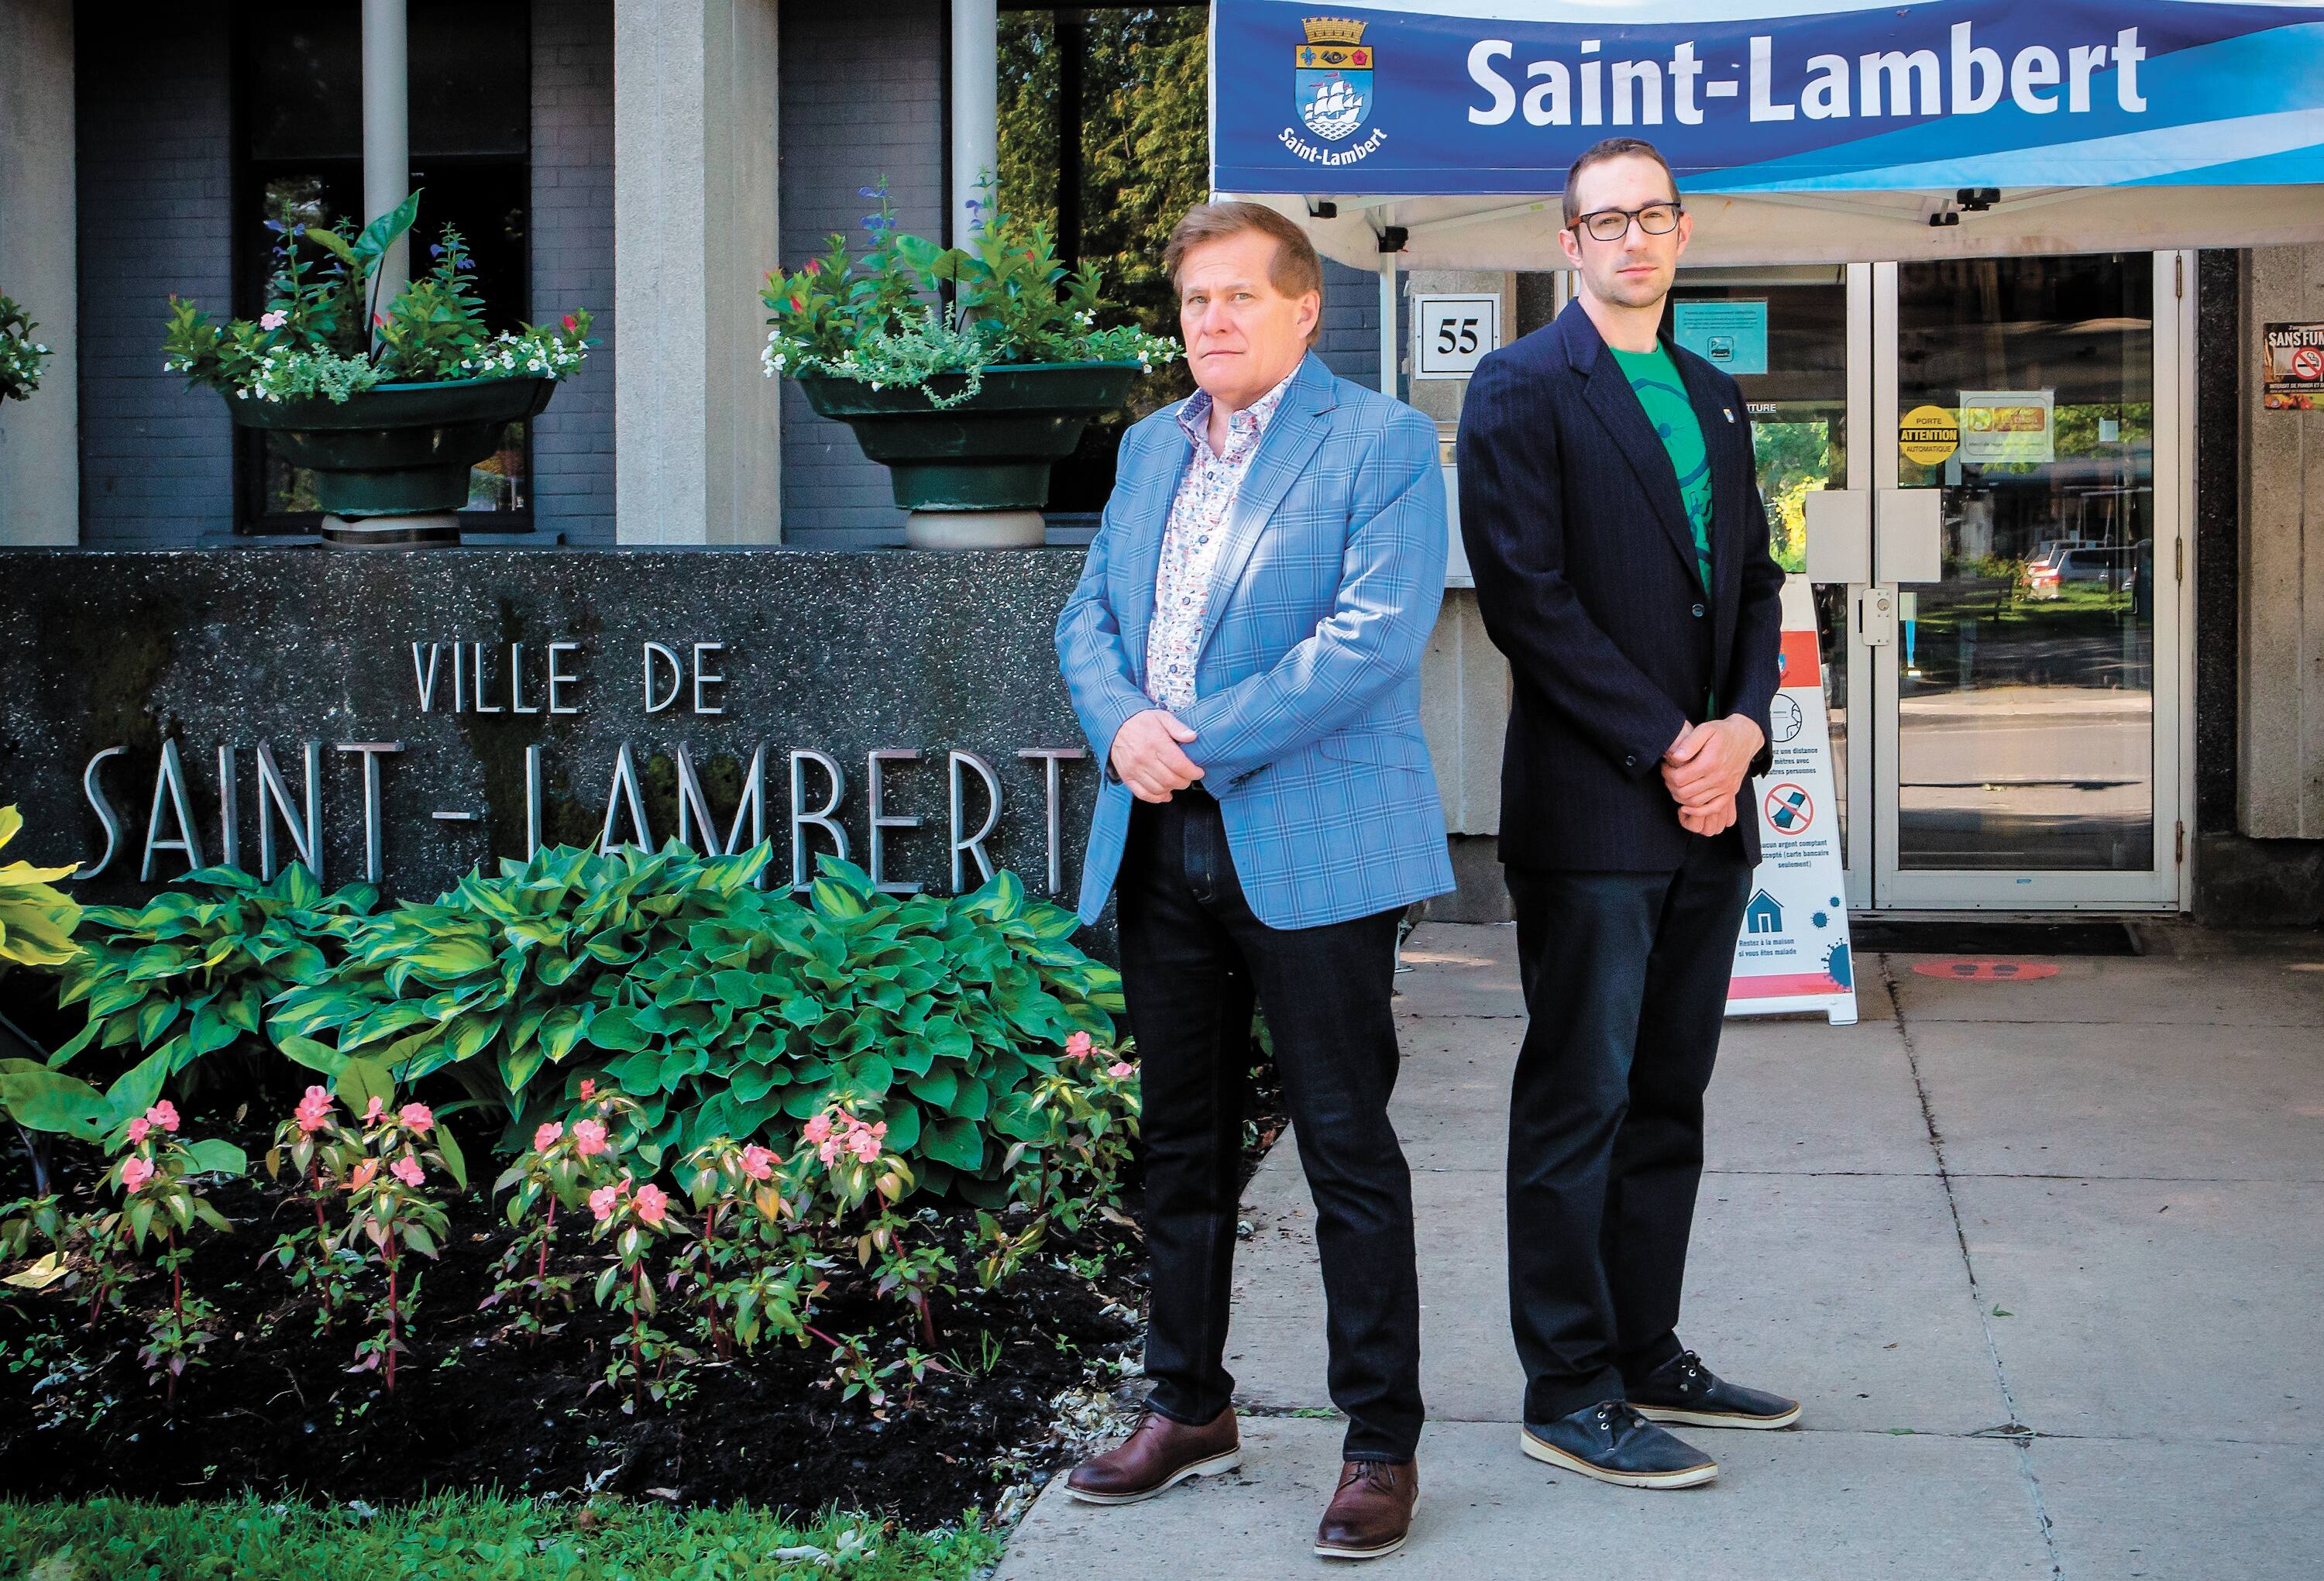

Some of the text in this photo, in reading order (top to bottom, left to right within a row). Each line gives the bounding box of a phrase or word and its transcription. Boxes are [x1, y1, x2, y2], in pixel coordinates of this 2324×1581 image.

[1467, 20, 2147, 125] Saint-Lambert
[1278, 127, 1388, 166] Saint-Lambert
[1438, 318, 1479, 354] 55
[2268, 332, 2301, 347] SANS
[1901, 430, 1958, 441] ATTENTION
[412, 641, 725, 714] VILLE DE
[73, 737, 404, 884] SAINT
[526, 741, 1085, 893] LAMBERT
